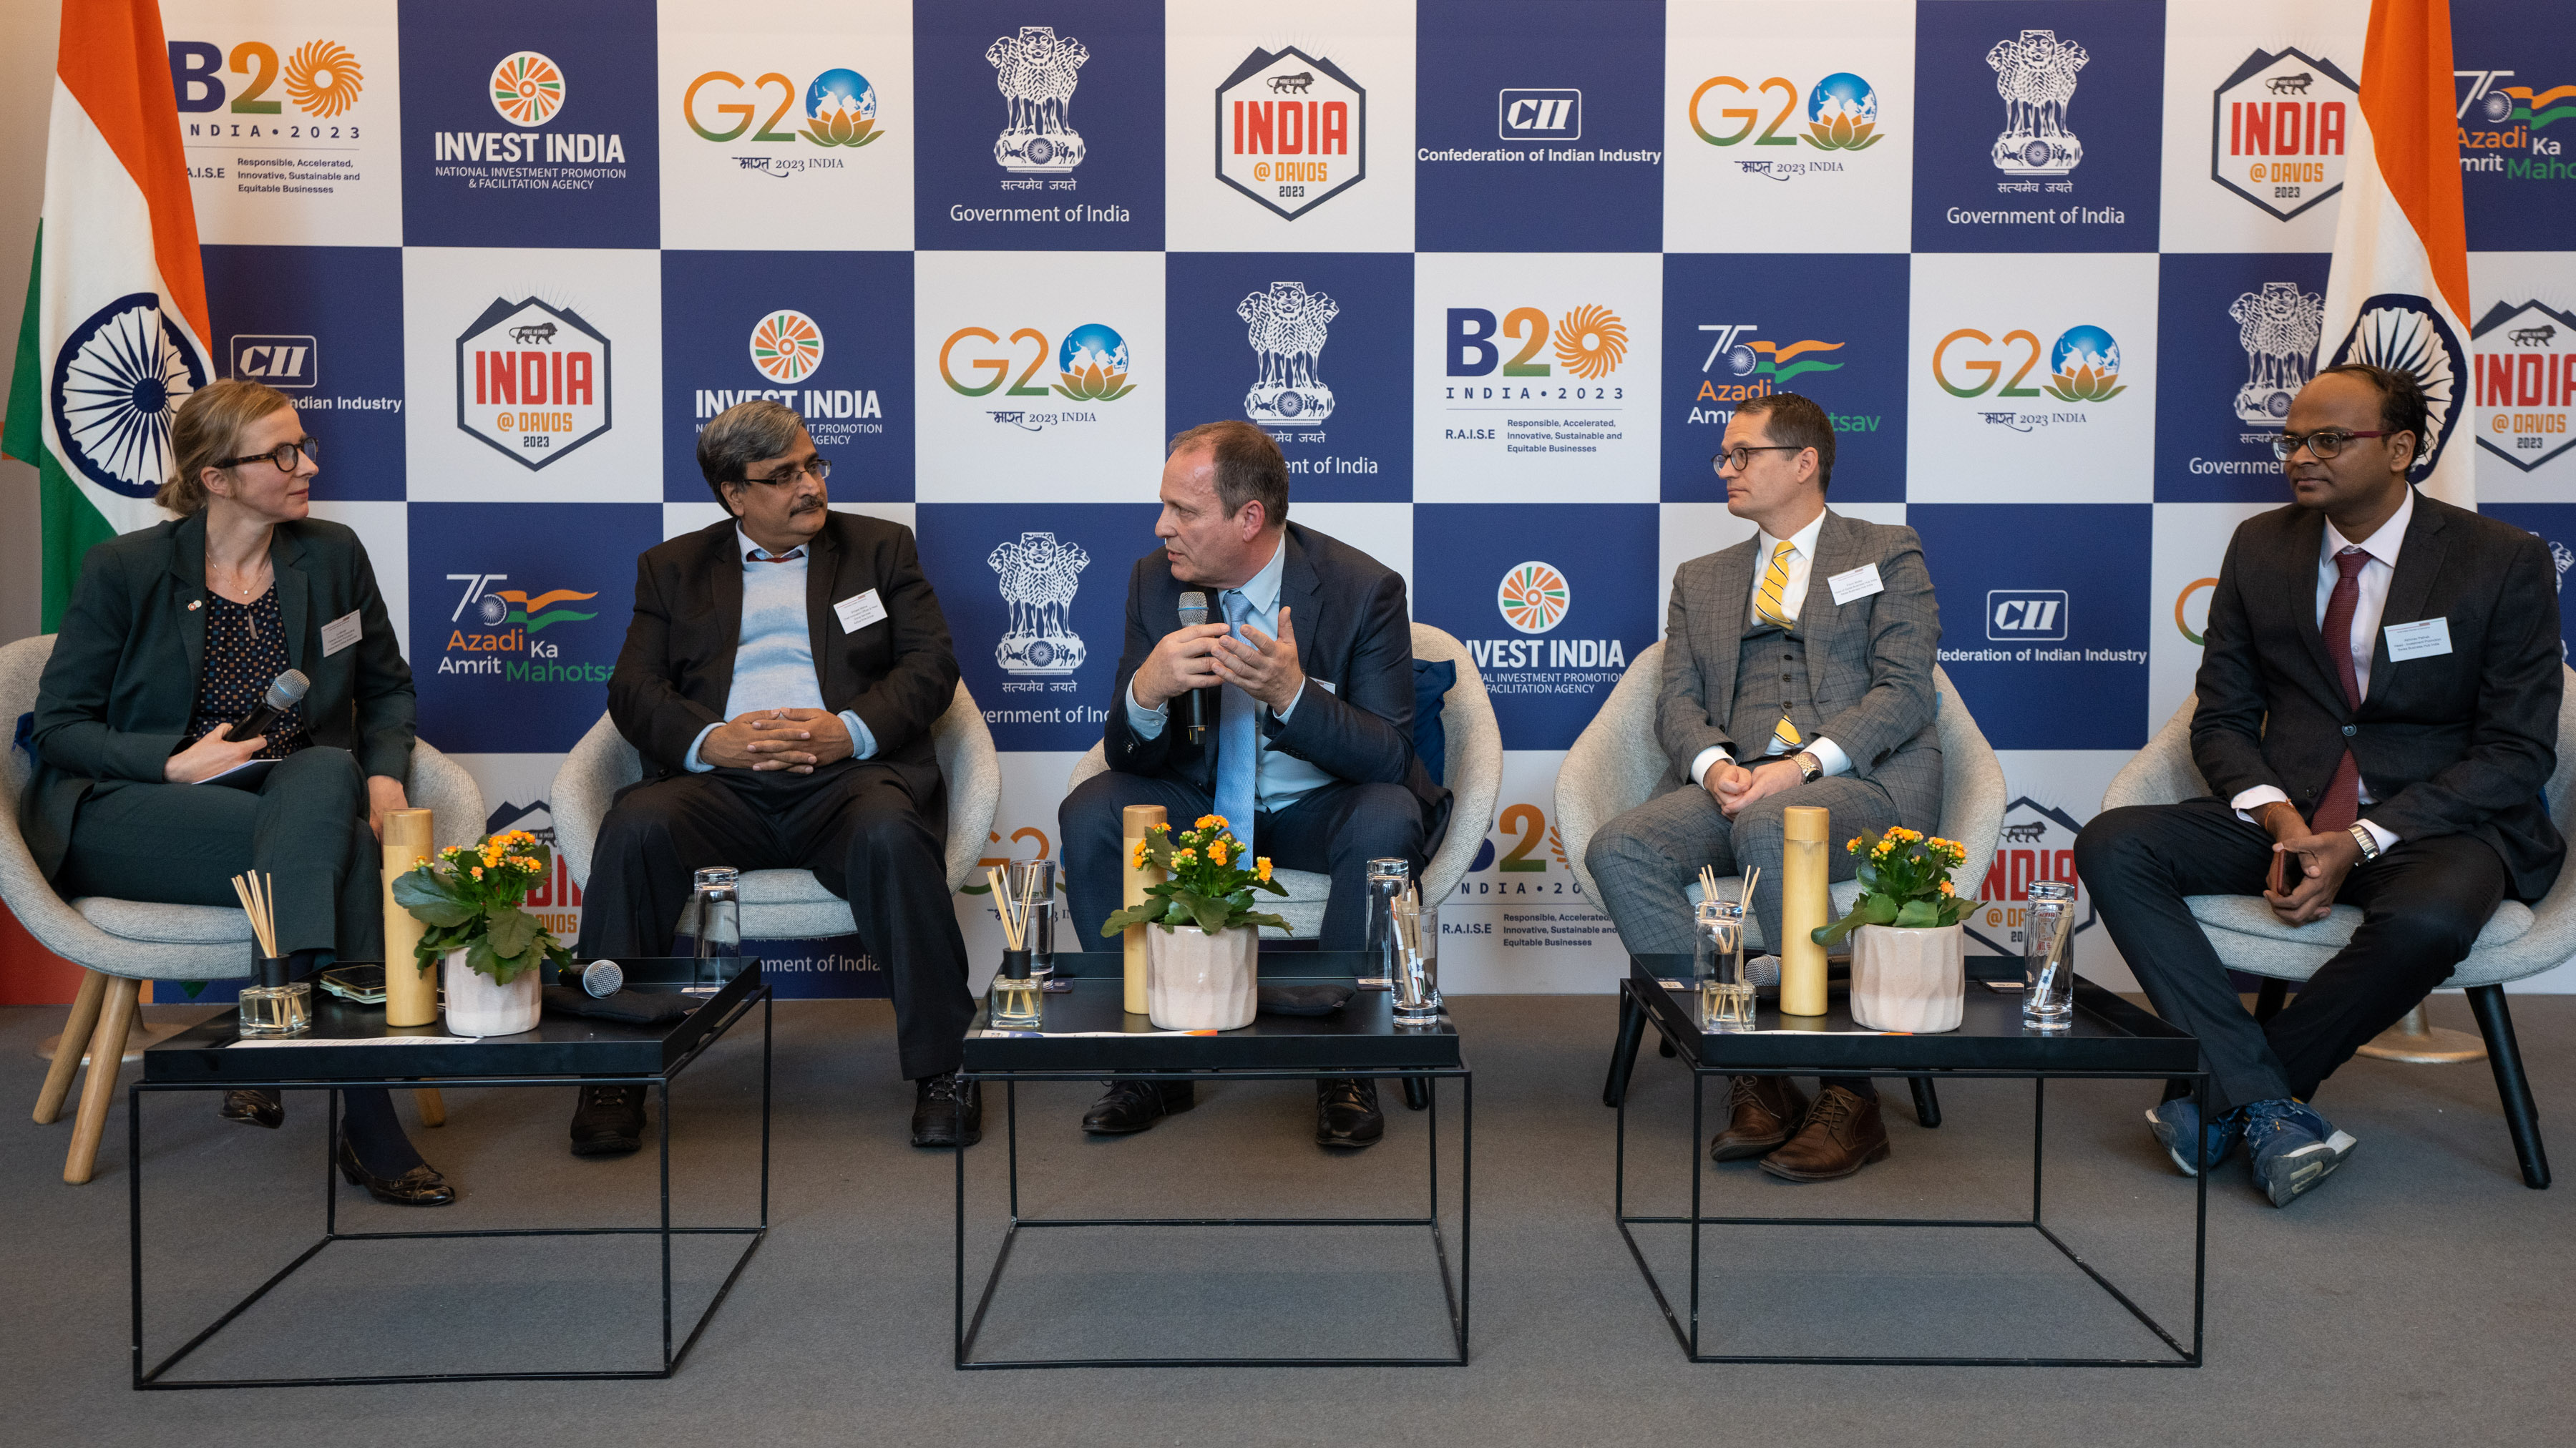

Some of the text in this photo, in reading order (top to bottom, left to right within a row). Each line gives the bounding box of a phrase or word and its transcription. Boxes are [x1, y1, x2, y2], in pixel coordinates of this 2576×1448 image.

[1506, 99, 1574, 129] CII
[190, 124, 359, 139] NDIA 2023
[1234, 101, 1347, 155] INDIA
[2230, 102, 2346, 156] INDIA
[2458, 125, 2527, 149] Azadi
[435, 132, 625, 163] INVEST INDIA
[2532, 137, 2561, 155] Ka
[238, 158, 353, 168] Responsible, Accelerated,
[1418, 148, 1662, 165] Confederation of Indian Industry
[2459, 152, 2504, 172] mrit
[435, 166, 626, 179] NATIONAL INVESTMENT PROMOTION
[776, 158, 844, 172] 2023 INDIA
[1254, 162, 1327, 182] @ DAVOS
[1777, 162, 1844, 175] 2023 INDIA
[2250, 162, 2324, 182] @ DAVOS
[238, 171, 287, 181] Innovative,
[288, 172, 342, 181] Sustainable
[1001, 177, 1077, 190] सत्यमेव जयते
[238, 184, 333, 194] Equitable Businesses
[469, 178, 594, 190] & FACILITATION AGENCY
[1279, 186, 1304, 197] 2023
[1997, 180, 2073, 193] सत्यमेव जयते
[2275, 187, 2301, 198] 2023
[950, 204, 1130, 222] Government of India
[1946, 206, 2125, 224] Government of India
[239, 346, 309, 377] CII
[476, 351, 592, 405] INDIA
[1446, 387, 1623, 399] INDIA 2023
[1697, 379, 1772, 401] Azadi
[289, 396, 402, 413] ndian Industry
[804, 390, 882, 419] INDIA
[497, 412, 572, 432] @ DAVOS
[1029, 412, 1096, 425] 2023 INDIA
[1507, 419, 1616, 429] Responsible, Accelerated,
[2019, 413, 2087, 426] 2023 INDIA
[2492, 414, 2567, 434] @ DAVOS
[819, 424, 882, 434] PROMOTION
[1298, 430, 1326, 443] जयते
[1445, 429, 1496, 439] R.A.I.S.E
[1507, 431, 1553, 441] Innovative,
[523, 436, 550, 447] 2023
[811, 435, 851, 445] AGENCY
[2517, 437, 2542, 449] 2023
[1507, 444, 1596, 454] Equitable Businesses
[1314, 456, 1332, 474] of
[1336, 456, 1378, 474] India
[2189, 457, 2285, 474] Governme
[1994, 600, 2061, 630] CII
[447, 629, 523, 652] Azadi
[530, 640, 558, 658] Ka
[1466, 640, 1626, 668] VEST INDIA
[1936, 648, 2147, 665] federation of Indian Industry
[437, 655, 615, 682] Amrit Mahots
[1497, 672, 1561, 683] INVESTMENT
[1002, 680, 1078, 693] सत्यमेव जयते
[1485, 683, 1595, 693] FACILITATION AGENCY
[1065, 705, 1084, 723] of
[1974, 849, 2079, 901] NDIA
[1461, 882, 1582, 894] NDIA 20
[1503, 914, 1557, 923] Responsible,
[1986, 908, 2003, 927] @
[1442, 924, 1492, 934] R.A.I.S.E
[1503, 926, 1549, 936] Innovative,
[1503, 939, 1543, 947] Equitable
[816, 954, 835, 972] of
